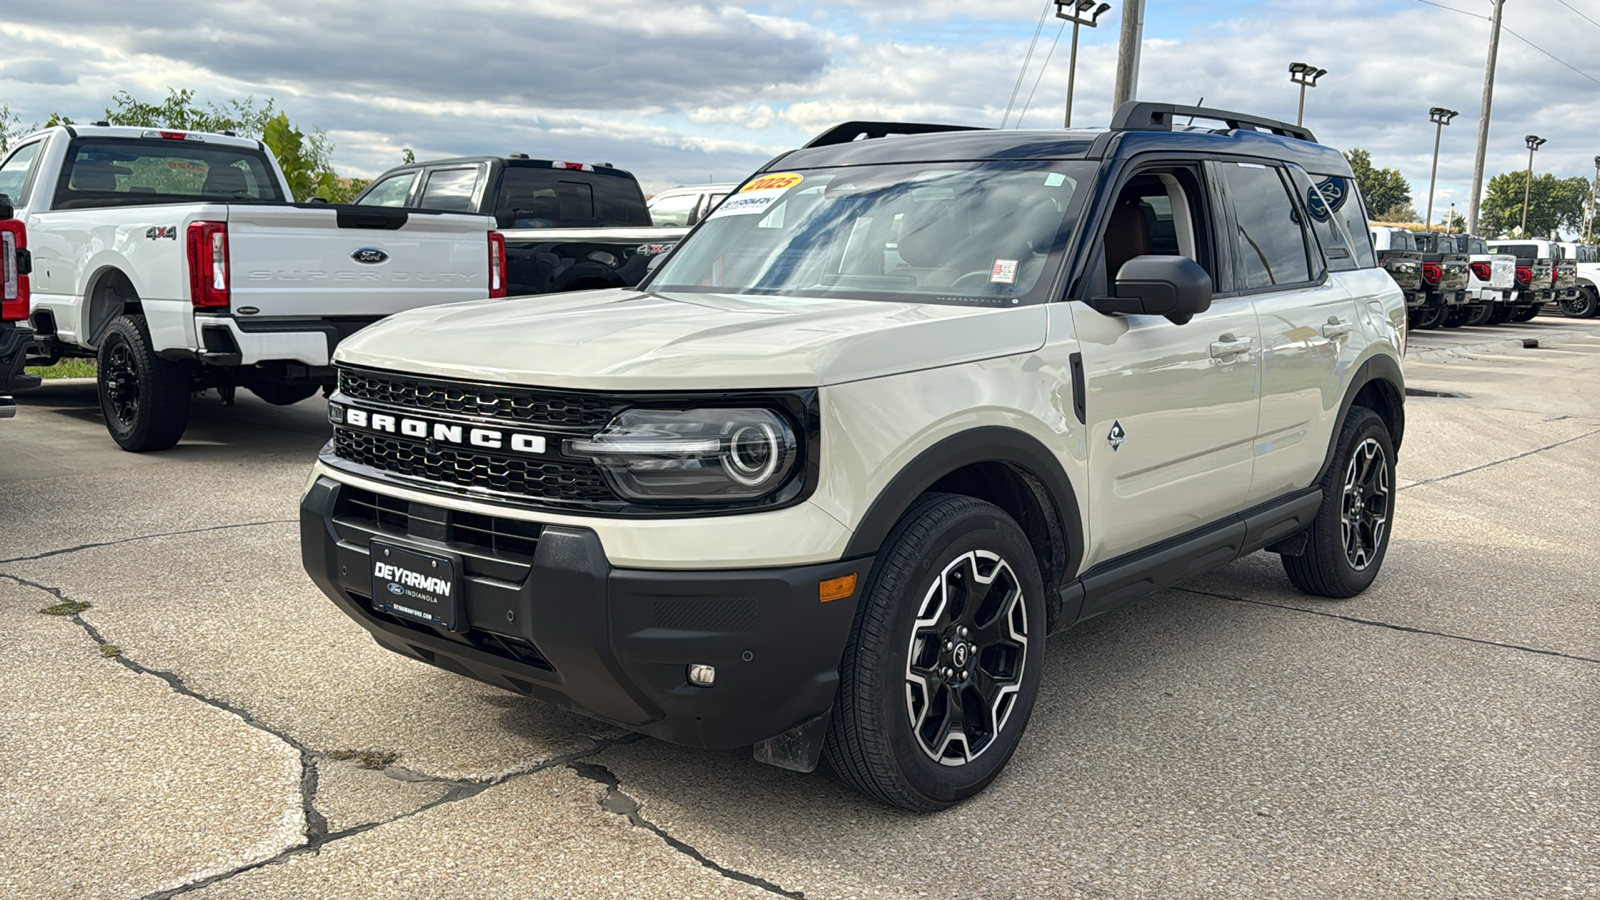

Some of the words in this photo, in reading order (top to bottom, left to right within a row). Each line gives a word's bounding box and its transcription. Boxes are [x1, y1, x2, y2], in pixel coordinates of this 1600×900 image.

[743, 177, 799, 192] 2025
[248, 270, 381, 282] SUPER
[391, 271, 478, 283] DUTY
[346, 408, 547, 454] BRONCO
[374, 561, 452, 597] DEYARMAN
[405, 589, 438, 604] INDIANOLA
